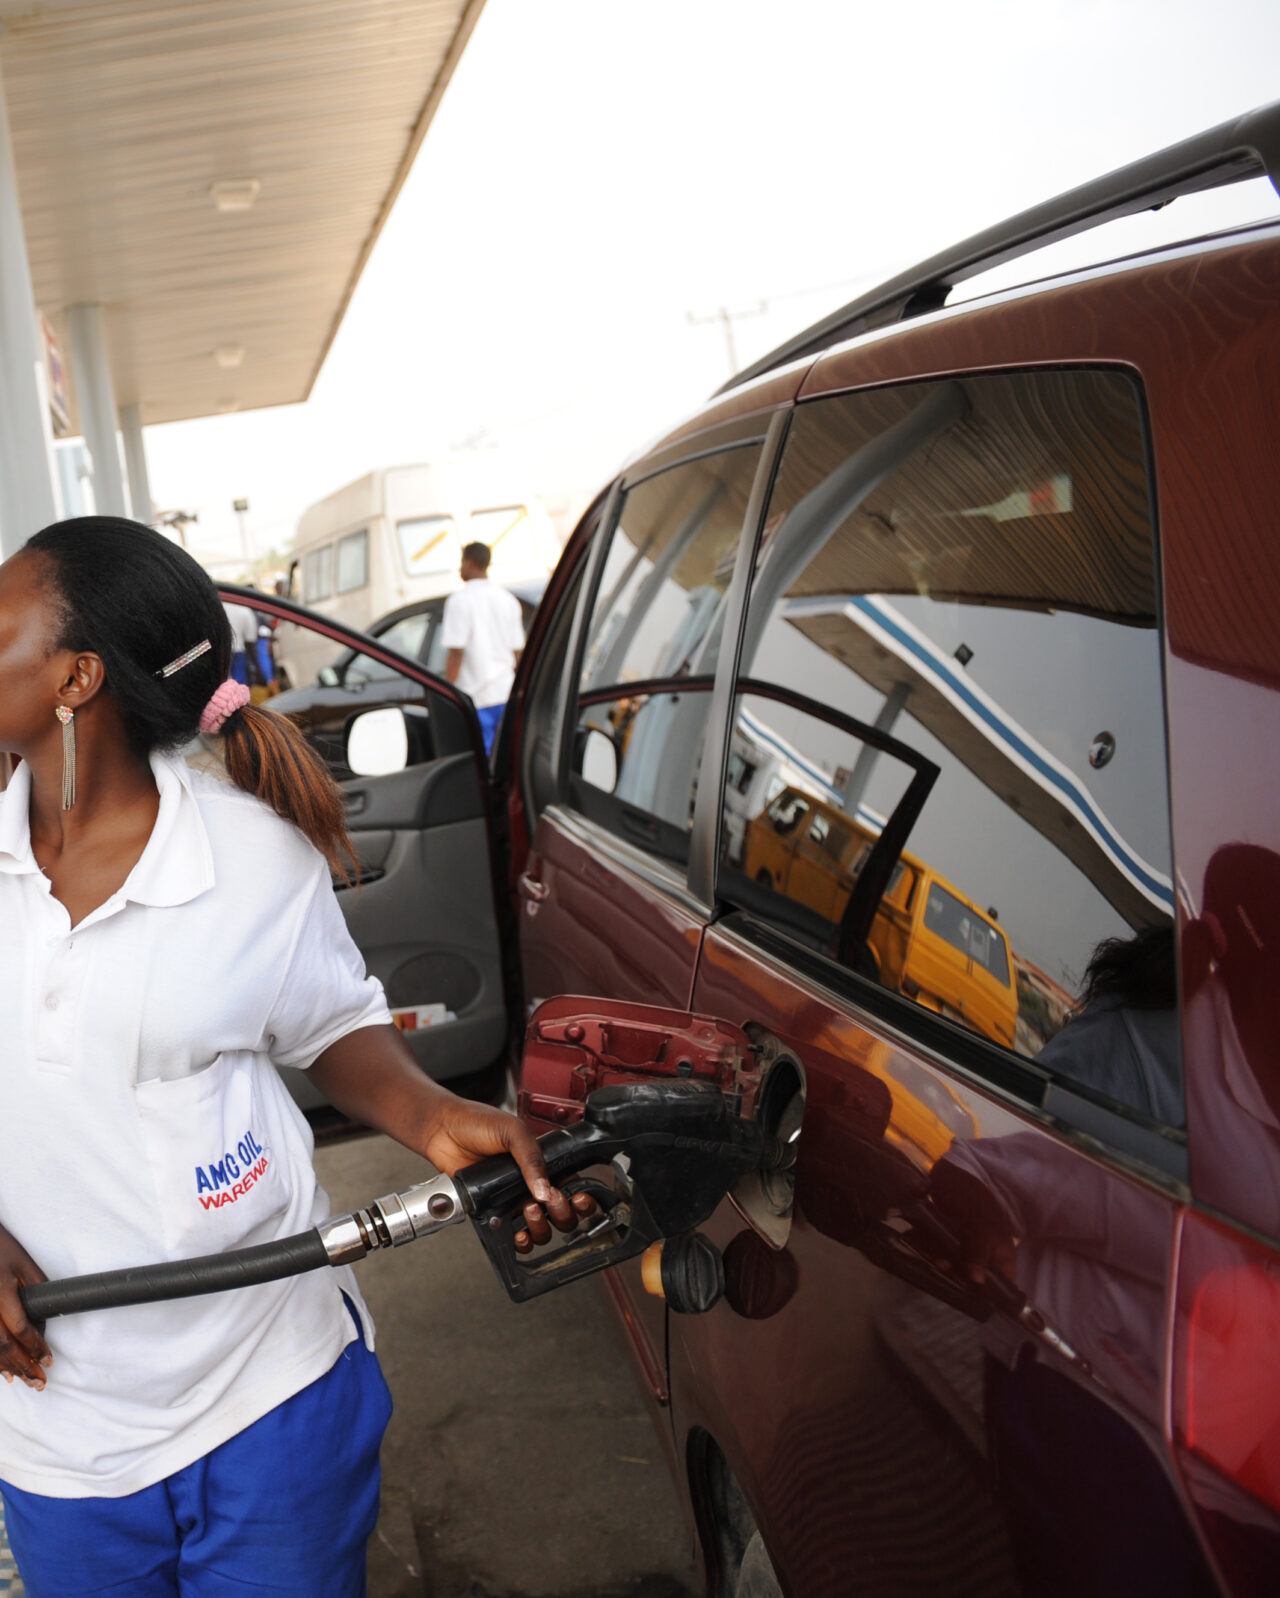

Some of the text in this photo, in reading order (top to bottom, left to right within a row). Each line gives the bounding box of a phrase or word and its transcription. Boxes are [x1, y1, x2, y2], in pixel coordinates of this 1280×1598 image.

[195, 1130, 262, 1194] AMC OIL
[198, 1157, 269, 1210] WAREWA
